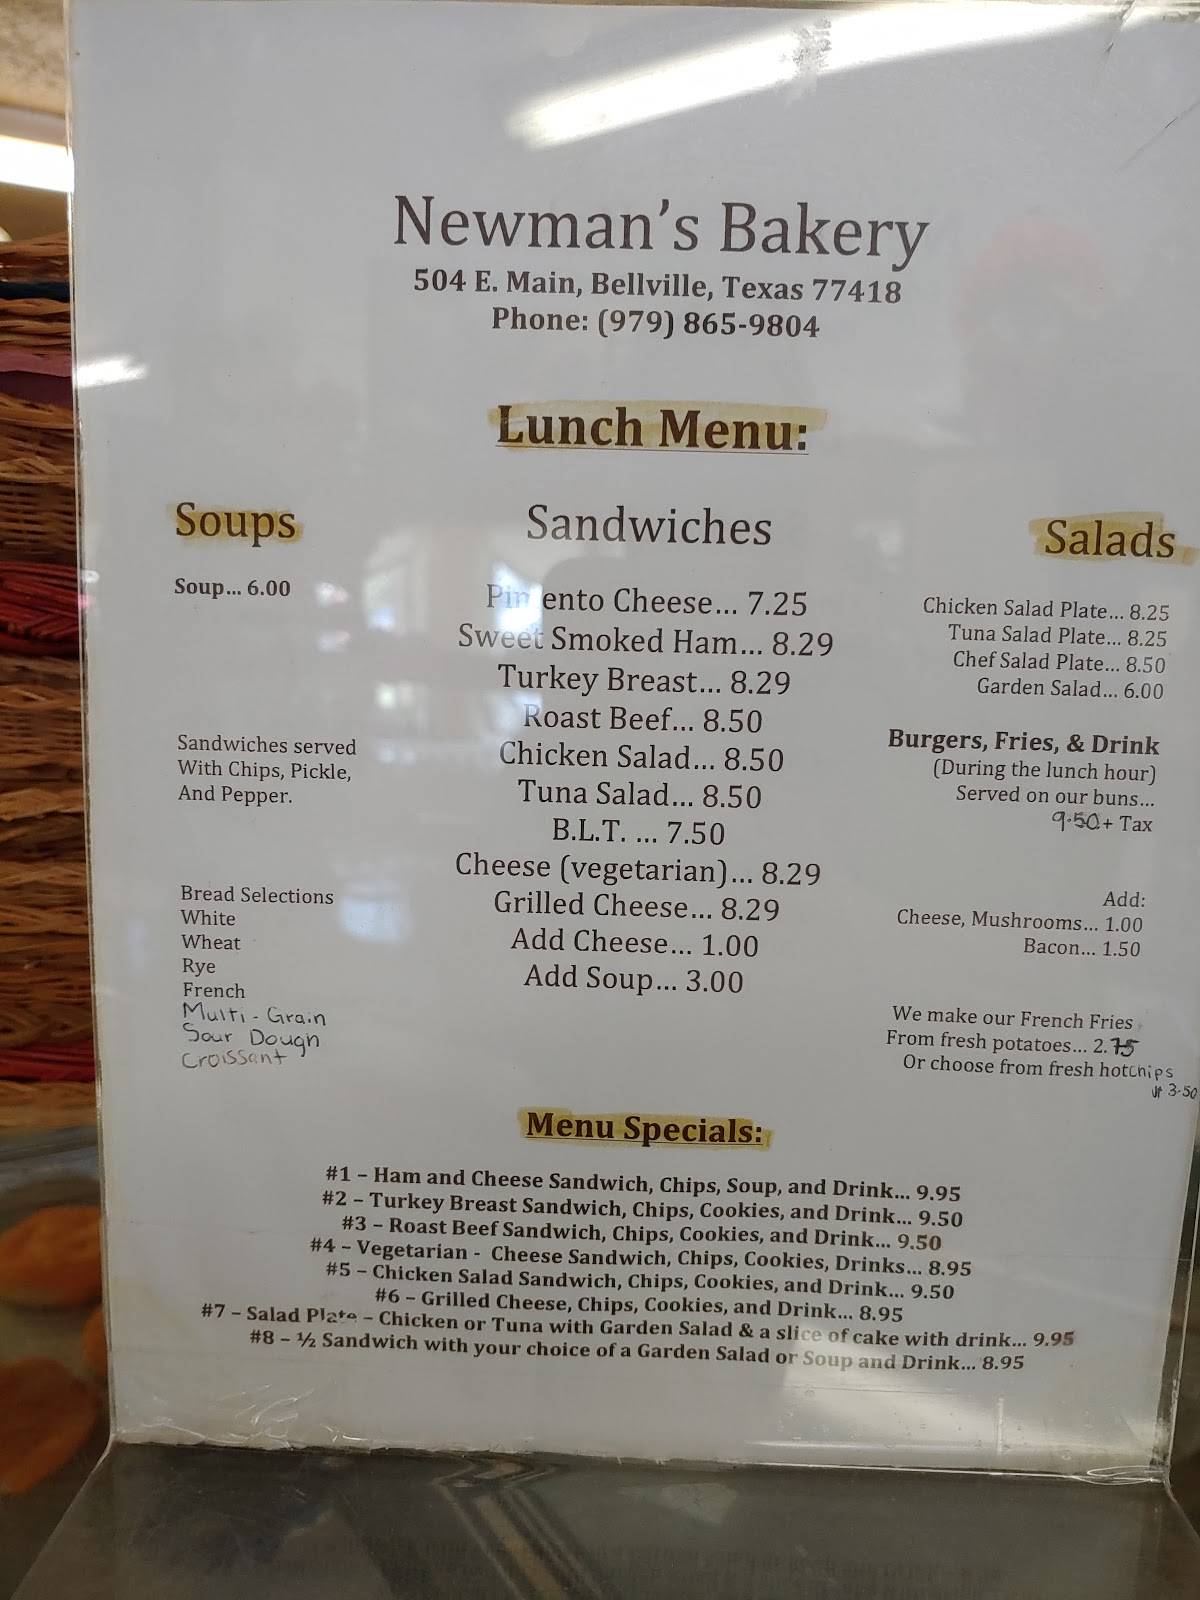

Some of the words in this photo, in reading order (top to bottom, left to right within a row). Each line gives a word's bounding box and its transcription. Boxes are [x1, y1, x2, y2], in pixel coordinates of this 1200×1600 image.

[719, 201, 930, 272] Bakery
[413, 267, 466, 291] 504
[474, 269, 497, 292] E.
[506, 270, 582, 298] Main,
[590, 271, 713, 301] Bellville,
[721, 275, 803, 300] Texas
[812, 278, 901, 304] 77418
[491, 306, 587, 331] Phone:
[598, 308, 673, 339] (979)
[683, 311, 820, 337] 865-9804
[497, 404, 643, 446] Lunch
[658, 409, 806, 450] Menu:
[176, 501, 295, 547] Soups
[527, 503, 771, 545] Sandwiches
[1044, 519, 1175, 557] Salads
[173, 577, 241, 599] Soup...
[247, 579, 290, 596] 6.00
[612, 587, 736, 615] Cheese...
[748, 590, 806, 616] 7.25
[922, 596, 997, 615] Chicken
[1003, 599, 1053, 617] Salad
[1059, 600, 1123, 619] Plate...
[1129, 603, 1169, 621] 8.25
[458, 622, 543, 649] Sweet
[551, 625, 663, 653] Smoked
[672, 628, 762, 655] Ham...
[772, 631, 833, 656] 8.29
[947, 623, 996, 641] Tuna
[1001, 625, 1051, 643] Salad
[1057, 626, 1120, 645] Plate...
[1127, 629, 1167, 647] 8.25
[953, 649, 997, 668] Chef
[999, 651, 1049, 670] Salad
[1055, 652, 1120, 672] Plate...
[1125, 655, 1165, 673] 8.50
[497, 663, 599, 696] Turkey
[606, 666, 720, 693] Breast...
[730, 670, 790, 695] 8.29
[977, 676, 1044, 695] Garden
[1050, 679, 1117, 698] Salad...
[1123, 682, 1163, 699] 6.00
[523, 703, 601, 729] Roast
[608, 705, 693, 731] Beef...
[703, 708, 762, 733] 8.50
[177, 734, 287, 753] Sandwiches
[293, 738, 356, 755] served
[499, 739, 608, 767] Chicken
[617, 743, 714, 770] Salad...
[724, 747, 783, 772] 8.50
[887, 728, 987, 753] Burgers,
[993, 731, 1059, 754] Fries,
[1066, 733, 1084, 752] &
[1090, 734, 1160, 755] Drink
[177, 759, 222, 776] With
[228, 760, 284, 781] Chips,
[290, 762, 351, 782] Pickle,
[933, 758, 1006, 780] (During
[1010, 759, 1040, 777] the
[1045, 760, 1098, 779] lunch
[1103, 763, 1155, 786] hour)
[177, 784, 215, 801] And
[220, 785, 292, 807] Pepper.
[517, 778, 588, 804] Tuna
[596, 780, 692, 807] Salad...
[702, 784, 761, 808] 8.50
[955, 784, 1020, 802] Served
[1026, 790, 1048, 803] on
[1055, 791, 1088, 804] our
[1092, 788, 1154, 806] buns...
[552, 817, 625, 842] B.L.T.
[667, 820, 724, 845] 7.50
[1119, 815, 1153, 832] Tax
[455, 851, 550, 877] Cheese
[560, 854, 752, 889] (vegetarian)...
[761, 861, 820, 886] 8.29
[180, 884, 235, 902] Bread
[240, 886, 333, 904] Selections
[494, 890, 584, 915] Grilled
[593, 892, 711, 919] Cheese...
[721, 897, 779, 921] 8.29
[1101, 890, 1145, 907] Add:
[179, 909, 235, 926] White
[897, 908, 965, 928] Cheese,
[971, 910, 1098, 931] Mushrooms...
[1104, 916, 1142, 932] 1.00
[180, 933, 241, 950] Wheat
[509, 927, 564, 951] Add
[573, 928, 691, 955] Cheese...
[702, 933, 758, 957] 1.00
[1023, 937, 1095, 955] Bacon...
[1102, 940, 1140, 957] 1.50
[181, 957, 215, 977] Rye
[522, 963, 578, 987] Add
[586, 965, 676, 996] Soup...
[685, 969, 743, 993] 3.00
[182, 981, 245, 998] French
[891, 1005, 921, 1021] We
[927, 1007, 977, 1024] make
[982, 1013, 1015, 1025] our
[1020, 1010, 1083, 1028] French
[1088, 1013, 1133, 1029] Fries
[182, 1021, 232, 1042] Sour
[885, 1029, 934, 1046] From
[940, 1031, 986, 1049] fresh
[991, 1036, 1086, 1054] potatoes...
[1092, 1036, 1140, 1057] 2.75
[903, 1053, 925, 1069] Or
[930, 1054, 994, 1073] choose
[999, 1058, 1043, 1076] from
[1047, 1060, 1093, 1077] fresh
[1098, 1061, 1128, 1078] hot
[526, 1111, 614, 1138] Menu
[623, 1115, 763, 1147] Specials:
[325, 1165, 351, 1181] #1
[373, 1166, 421, 1184] Ham
[426, 1169, 466, 1185] and
[471, 1169, 543, 1188] Cheese
[548, 1172, 653, 1195] Sandwich,
[659, 1176, 720, 1197] Chips,
[726, 1177, 781, 1197] Soup,
[787, 1178, 826, 1195] and
[832, 1179, 909, 1199] Drink...
[916, 1184, 960, 1201] 9.95
[249, 1328, 274, 1344] #8
[321, 1331, 418, 1350] Sandwich
[423, 1336, 468, 1354] with
[472, 1342, 521, 1358] your
[525, 1340, 590, 1357] choice
[595, 1341, 617, 1357] of
[619, 1345, 631, 1357] a
[636, 1342, 710, 1360] Garden
[715, 1345, 769, 1363] Salad
[775, 1352, 798, 1364] or
[802, 1350, 853, 1372] Soup
[857, 1353, 896, 1369] and
[900, 1354, 975, 1370] Drink...
[979, 1354, 1024, 1370] 8.95
